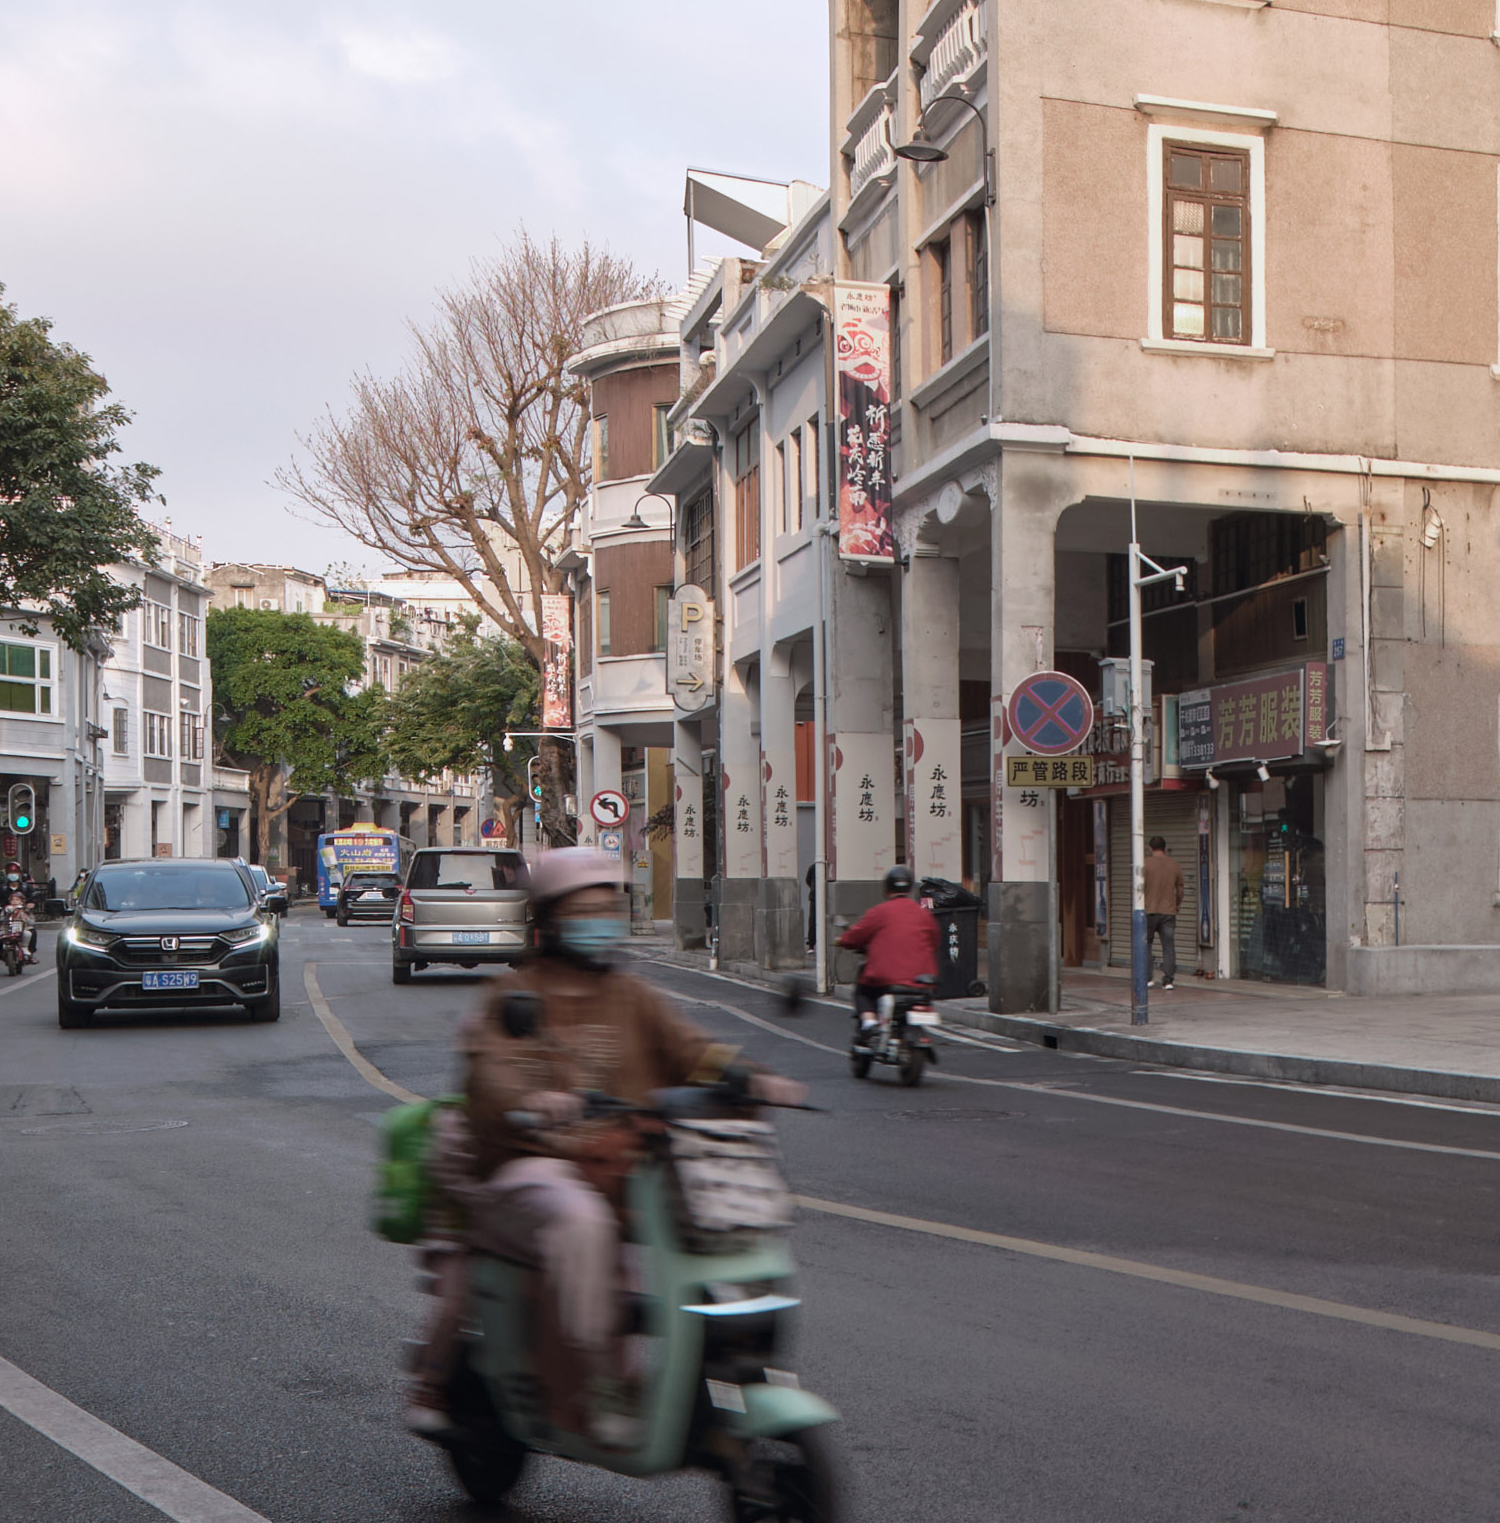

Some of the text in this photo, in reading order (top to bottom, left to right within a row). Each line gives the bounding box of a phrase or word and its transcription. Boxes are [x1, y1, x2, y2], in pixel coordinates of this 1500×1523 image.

[865, 404, 888, 491] 祈愿新年
[681, 602, 704, 633] P
[1217, 684, 1301, 750] 芳芳服装
[1309, 670, 1324, 740] 芳芳服装
[1011, 761, 1088, 783] 严管路段
